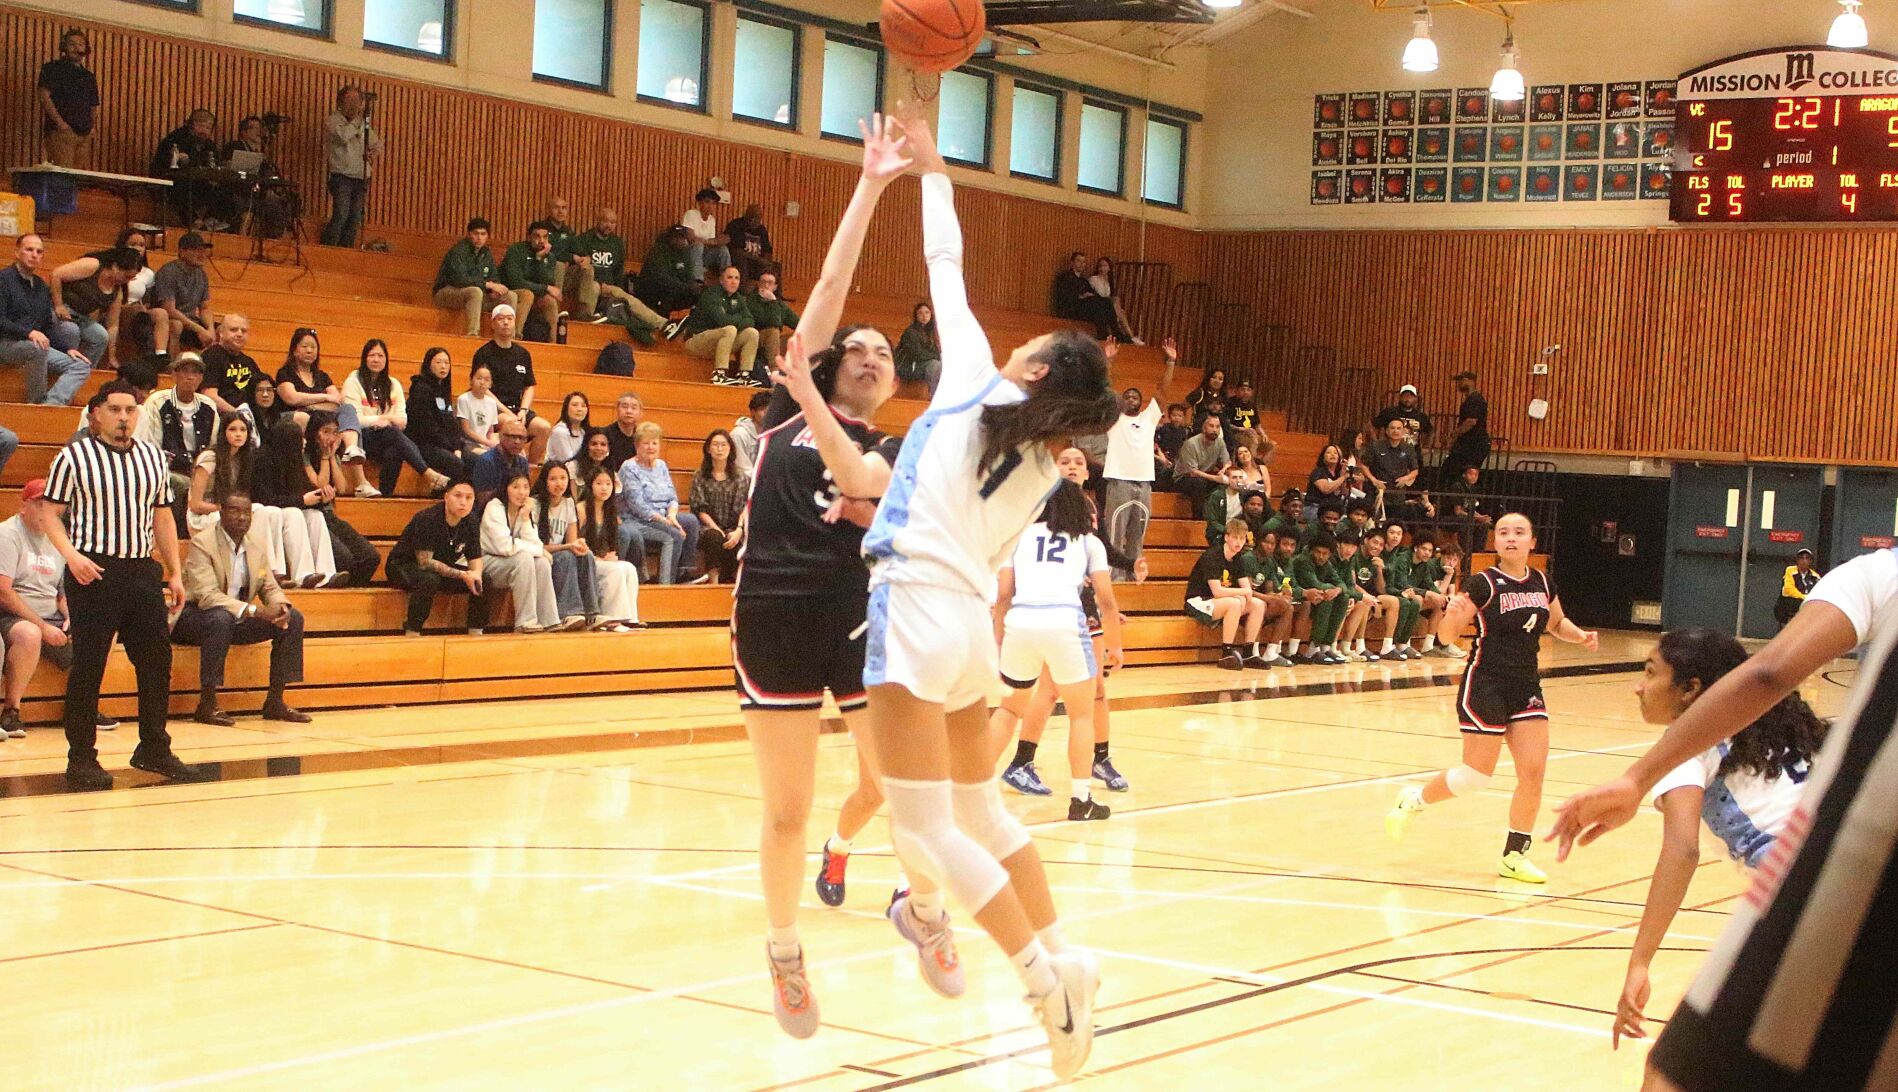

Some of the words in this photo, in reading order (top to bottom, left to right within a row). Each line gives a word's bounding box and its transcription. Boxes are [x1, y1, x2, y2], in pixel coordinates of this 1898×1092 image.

[1579, 85, 1594, 93] Kim
[1650, 81, 1677, 90] Jordan
[1689, 73, 1780, 93] MISSION
[1498, 114, 1519, 123] Lynch
[1538, 112, 1556, 121] Kelly
[1708, 120, 1732, 151] 15
[1776, 150, 1812, 166] period
[1607, 165, 1633, 173] FELICIA
[1689, 176, 1710, 189] FLS
[1727, 175, 1745, 189] TOL
[1771, 175, 1814, 188] PLAYER
[1840, 174, 1859, 188] TOL
[1697, 194, 1710, 216] 2
[1729, 194, 1742, 215] 5
[1841, 194, 1856, 213] 4
[1036, 535, 1068, 564] 12
[1522, 613, 1537, 632] 4
